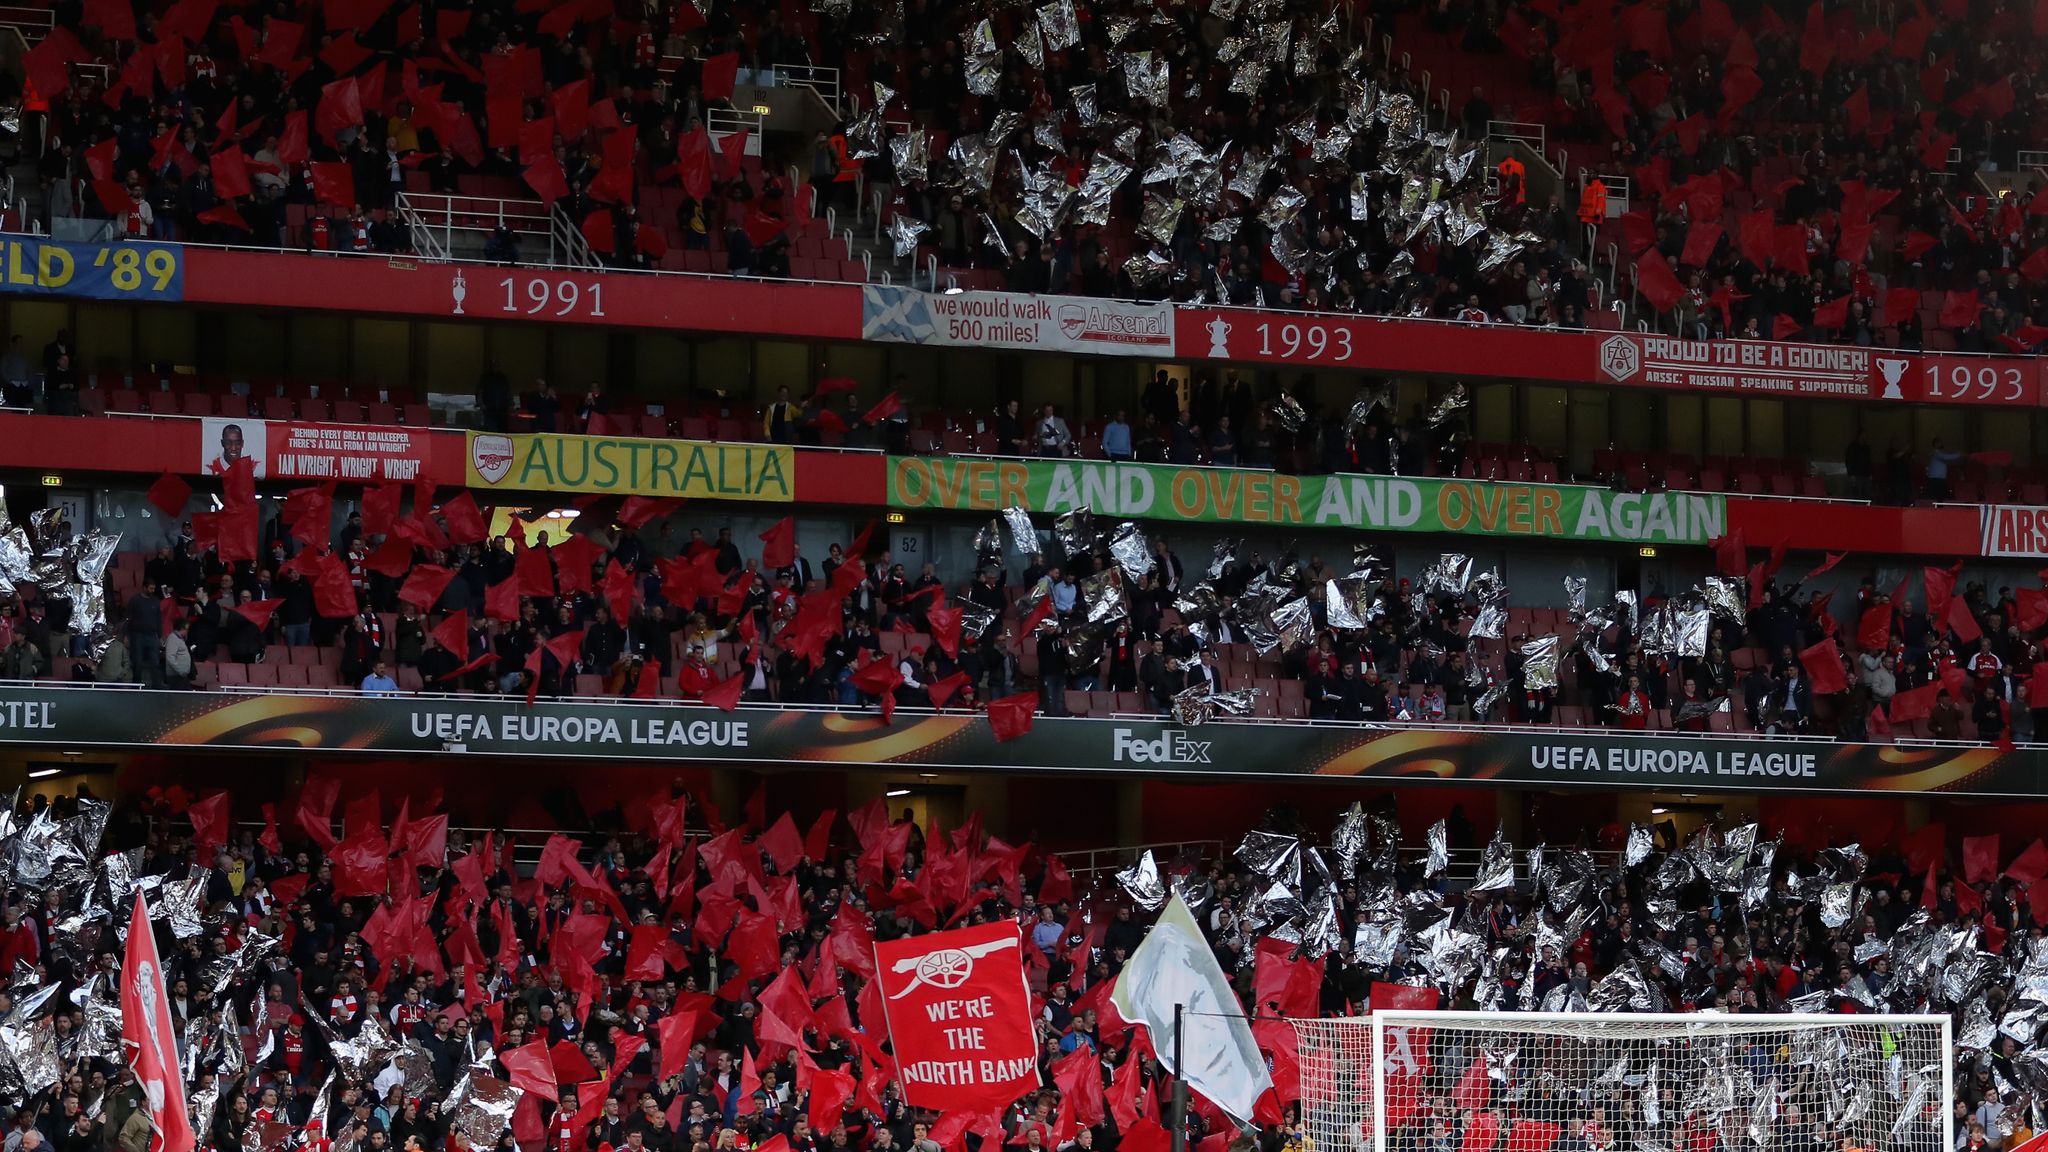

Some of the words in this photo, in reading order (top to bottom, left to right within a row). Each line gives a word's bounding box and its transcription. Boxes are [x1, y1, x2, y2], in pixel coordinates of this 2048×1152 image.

[0, 241, 75, 288] LD
[94, 247, 176, 291] '89
[500, 278, 605, 317] 1991
[934, 298, 957, 315] we
[960, 297, 1009, 318] would
[1013, 299, 1052, 320] walk
[949, 319, 983, 341] 500
[988, 321, 1039, 343] miles!
[1086, 306, 1167, 335] Arsenal
[1107, 334, 1148, 343] SCOTLAND
[1256, 323, 1352, 361] 1993
[1644, 337, 1709, 363] PROUD
[1713, 342, 1736, 364] TO
[1741, 344, 1766, 366] BE
[1771, 346, 1783, 367] A
[1788, 348, 1869, 371] GOONER!
[1645, 371, 1683, 384] ARSSC:
[1688, 375, 1735, 388] RUSSIAN
[1740, 377, 1793, 391] SPEAKING
[1799, 380, 1869, 394] SUPPORTERS
[1926, 365, 2023, 400] 1993
[288, 438, 317, 449] THERE'S
[318, 440, 324, 449] A
[325, 440, 342, 450] BALL
[344, 441, 364, 451] FROM
[365, 442, 377, 452] IAN
[321, 429, 341, 440] EVERY
[343, 430, 366, 441] GREAT
[367, 431, 409, 443] GOALKEEPER
[278, 454, 295, 475] IAN
[297, 454, 339, 478] WRIGHT,
[383, 458, 421, 480] WRIGHT
[519, 438, 789, 496] AUSTRALIA
[62, 501, 77, 518] 51
[895, 457, 1031, 511] OVER
[1043, 463, 1156, 515] AND
[1171, 469, 1302, 522] OVER
[1315, 477, 1422, 527] AND
[1437, 482, 1563, 535] OVER
[1574, 489, 1722, 541] AGAIN
[902, 537, 917, 553] 52
[1997, 509, 2048, 554] ARS
[411, 712, 494, 740] UEFA
[501, 715, 623, 743] EUROPA
[631, 719, 749, 747] LEAGUE
[1113, 728, 1212, 764] FedEx
[1530, 745, 1601, 771] UEFA
[1607, 748, 1710, 774] EUROPA
[1716, 752, 1816, 778] LEAGUE
[925, 995, 994, 1022] WE'RE
[943, 1027, 986, 1050] THE
[903, 1059, 974, 1085] NORTH
[980, 1056, 1035, 1083] BANK
